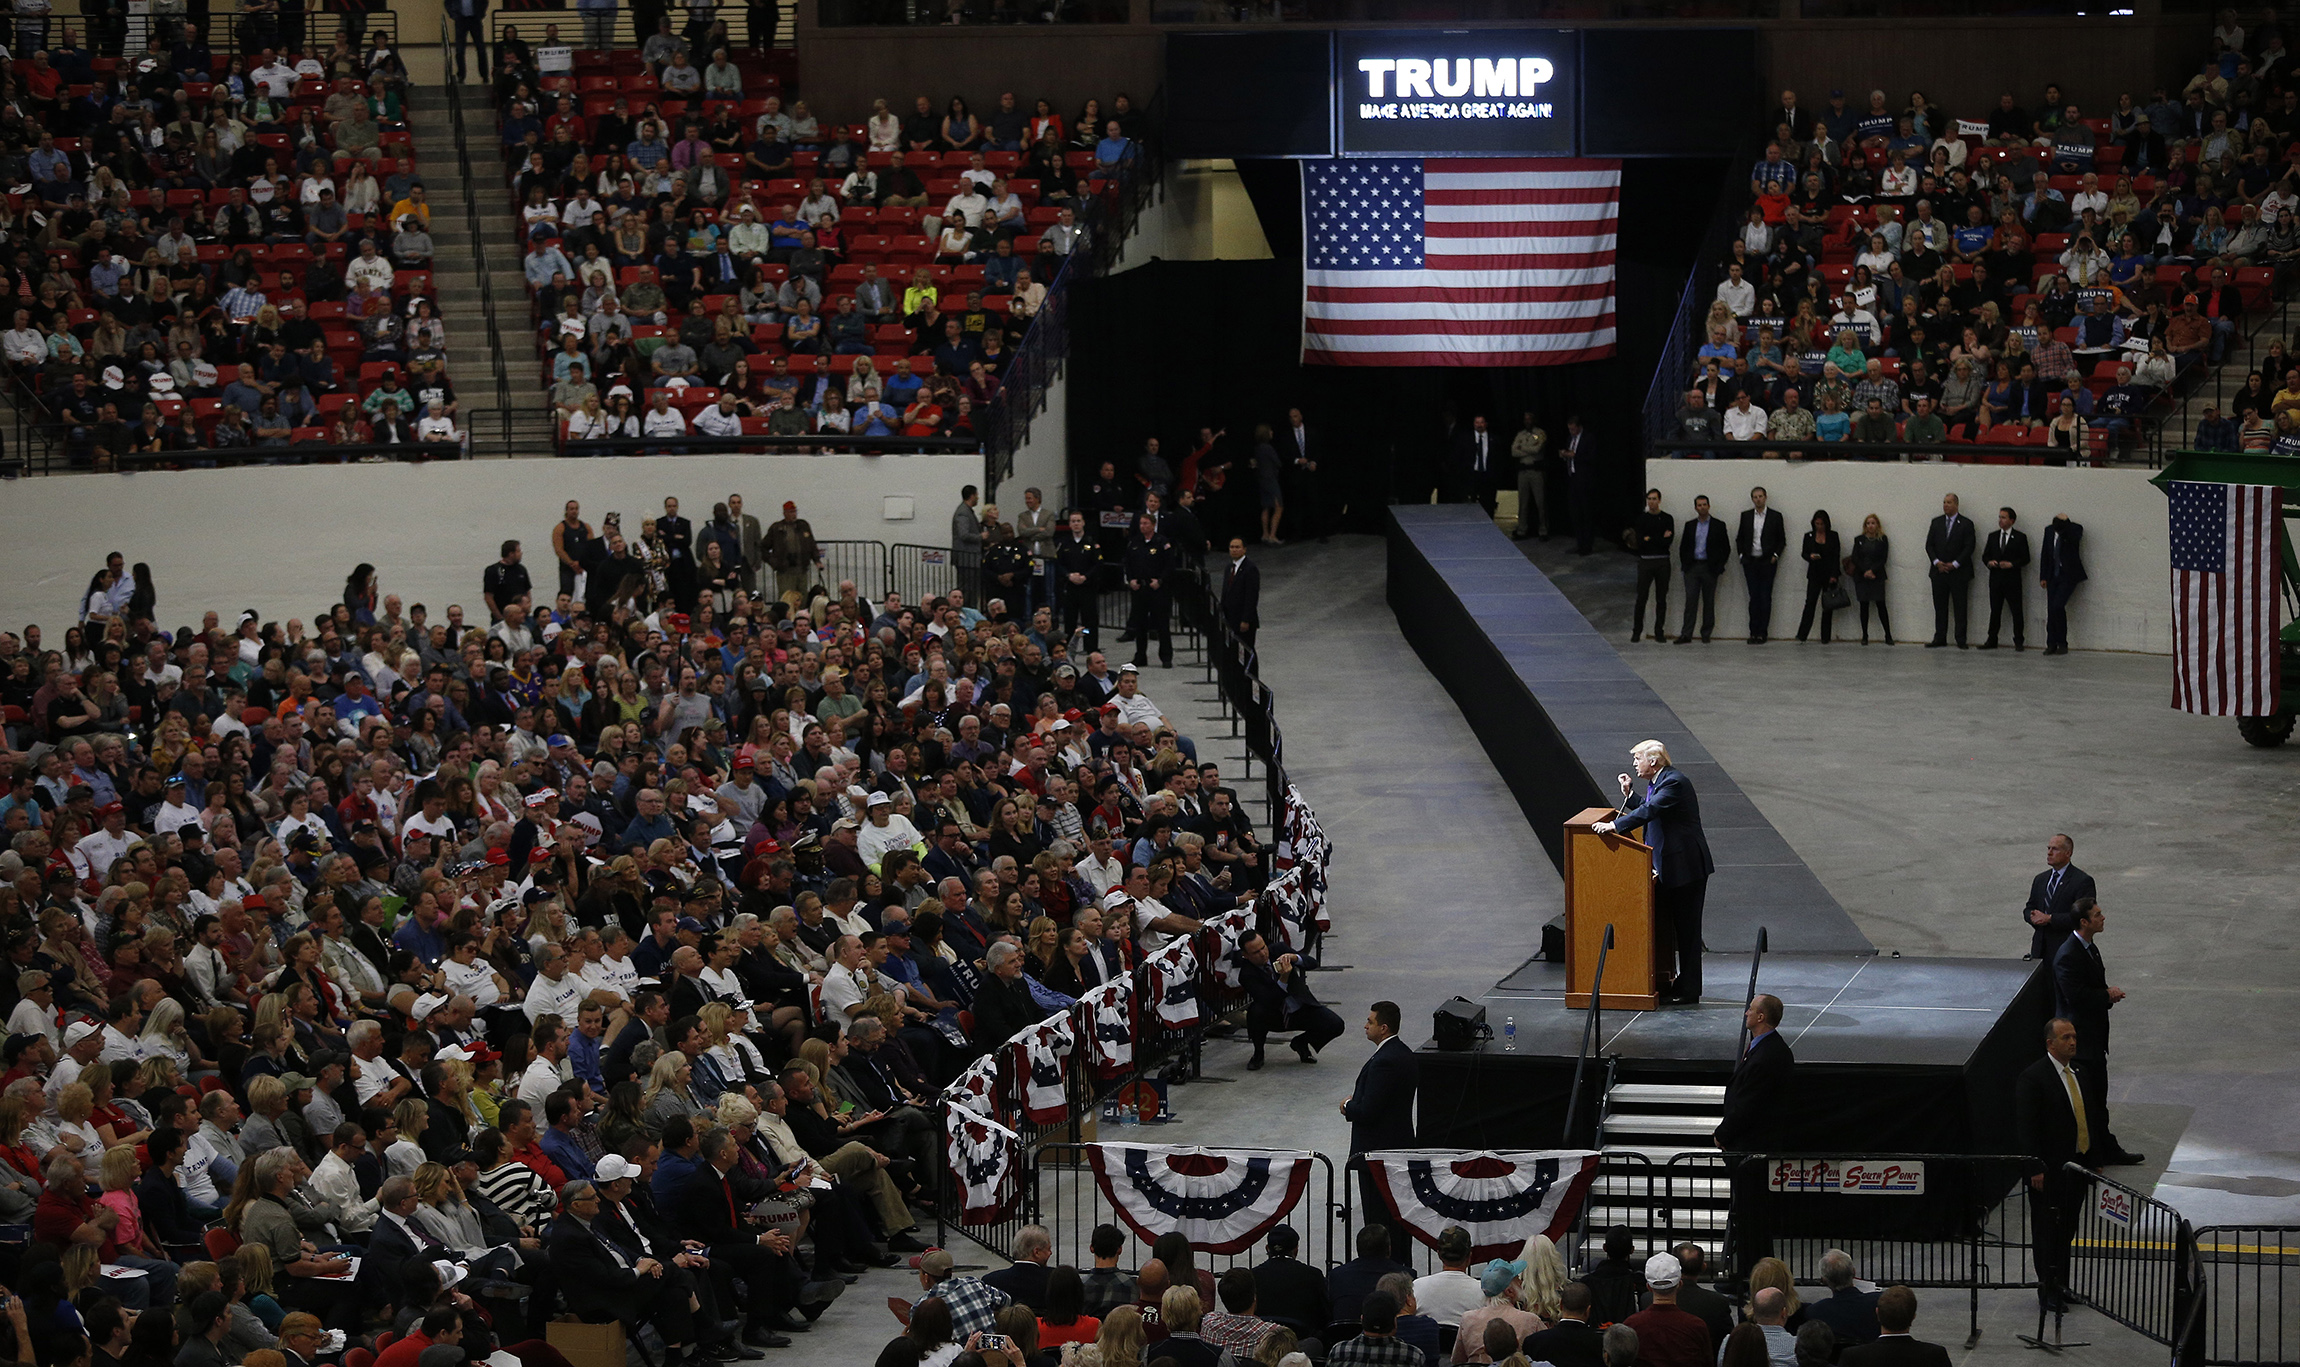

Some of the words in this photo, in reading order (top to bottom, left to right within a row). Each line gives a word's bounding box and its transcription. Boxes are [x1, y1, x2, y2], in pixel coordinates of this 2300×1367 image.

[1358, 57, 1554, 98] TRUMP
[1360, 103, 1398, 119] MAKE
[1400, 103, 1460, 119] AMERICA
[1461, 103, 1506, 119] GREAT
[1506, 103, 1553, 119] AGAIN!
[1858, 117, 1893, 128] TRUMP
[1961, 124, 1989, 132] RUMP
[2057, 144, 2093, 153] TRUMP
[194, 369, 217, 379] TRUMP
[957, 958, 980, 990] TRU
[1810, 1162, 1840, 1186] POIN
[1843, 1165, 1882, 1188] SOUTH
[1882, 1165, 1920, 1189] POINT
[754, 1212, 797, 1224] TRUMP
